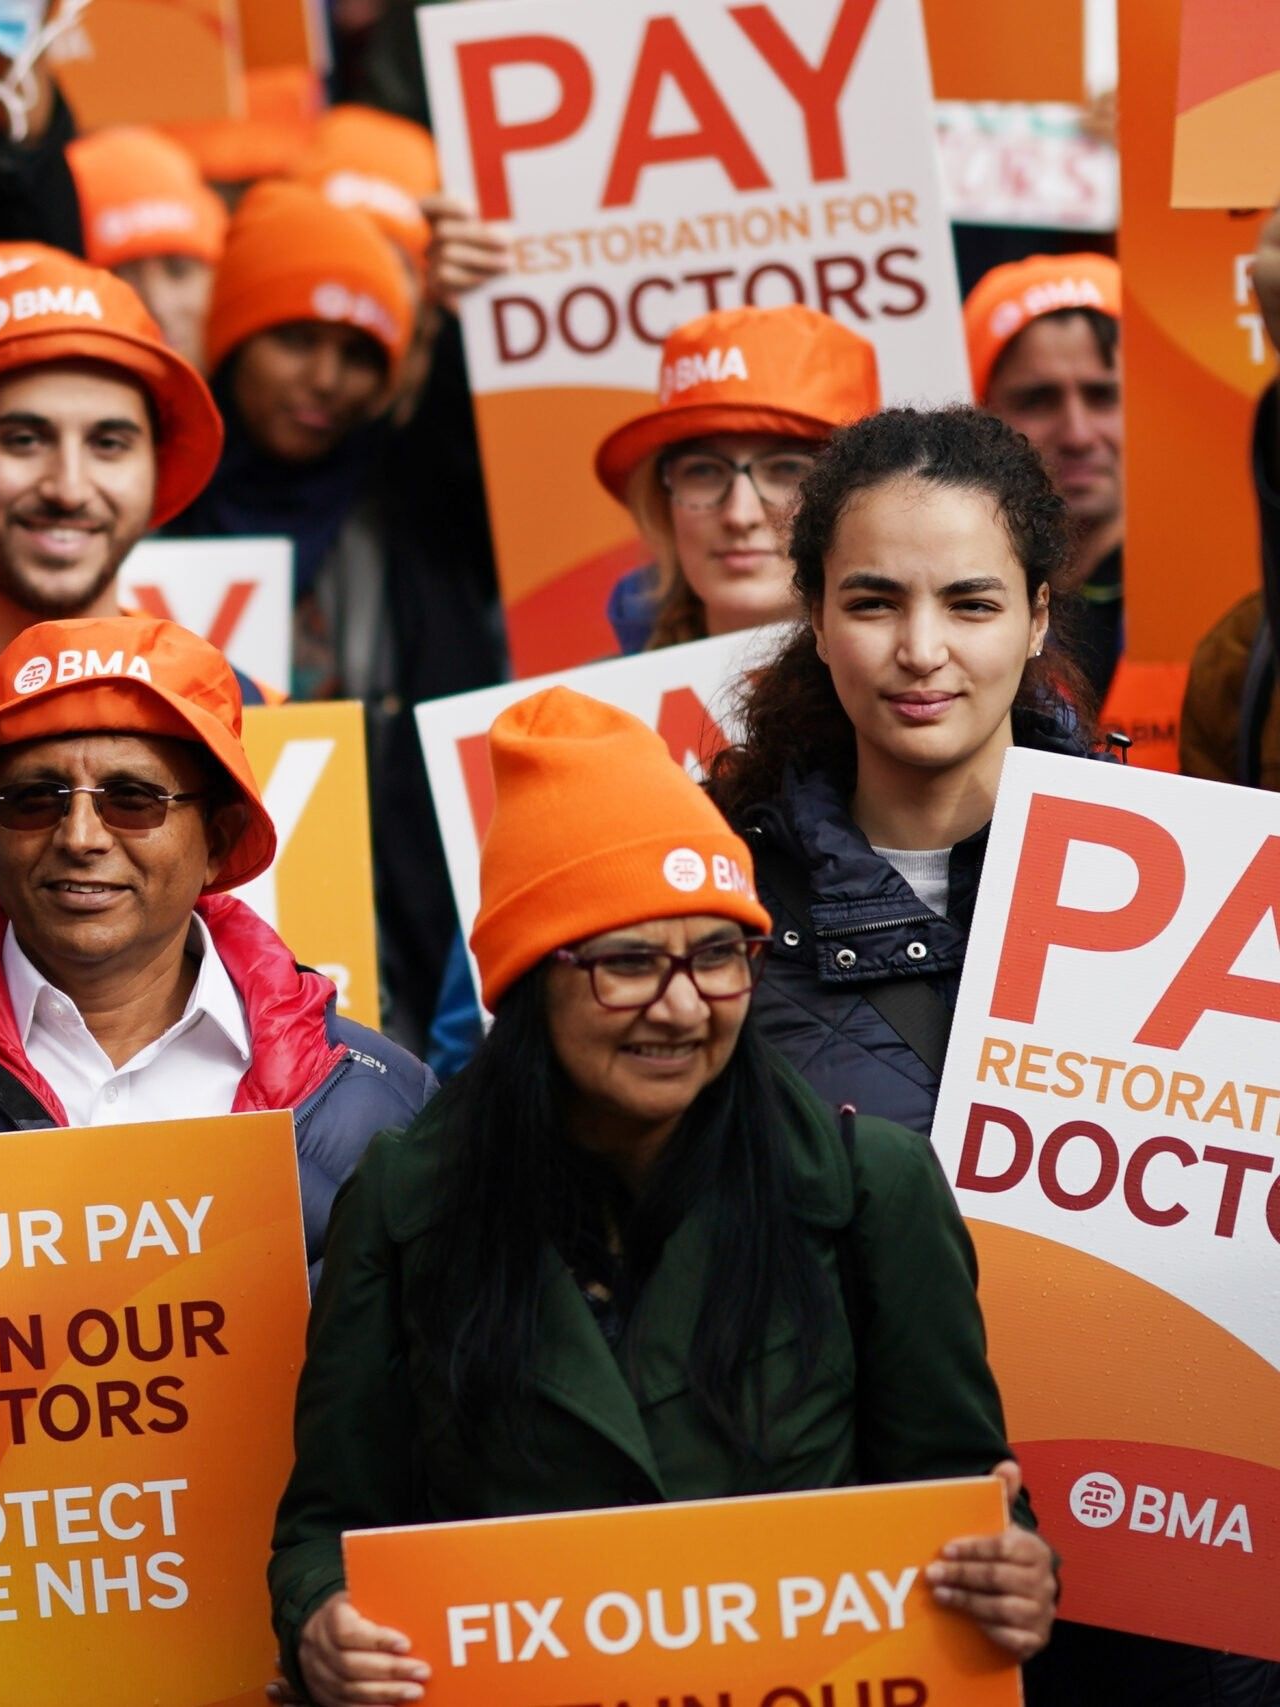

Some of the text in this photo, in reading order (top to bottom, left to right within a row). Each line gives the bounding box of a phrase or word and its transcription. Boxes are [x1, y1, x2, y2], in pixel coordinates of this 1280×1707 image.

[455, 0, 879, 221] PAY
[510, 190, 918, 275] ESTORATION FOR
[12, 286, 104, 321] BMA
[675, 347, 748, 392] BMA
[56, 650, 152, 684] BMA
[988, 792, 1280, 1051] PA
[976, 1037, 1280, 1136] RESTORAT
[955, 1101, 1280, 1246] DOCT
[83, 1195, 215, 1262] PAY
[66, 1300, 229, 1367] OUR
[1128, 1485, 1254, 1553] BMA
[34, 1551, 190, 1618] NHS
[446, 1566, 920, 1667] FIX OUR PAY
